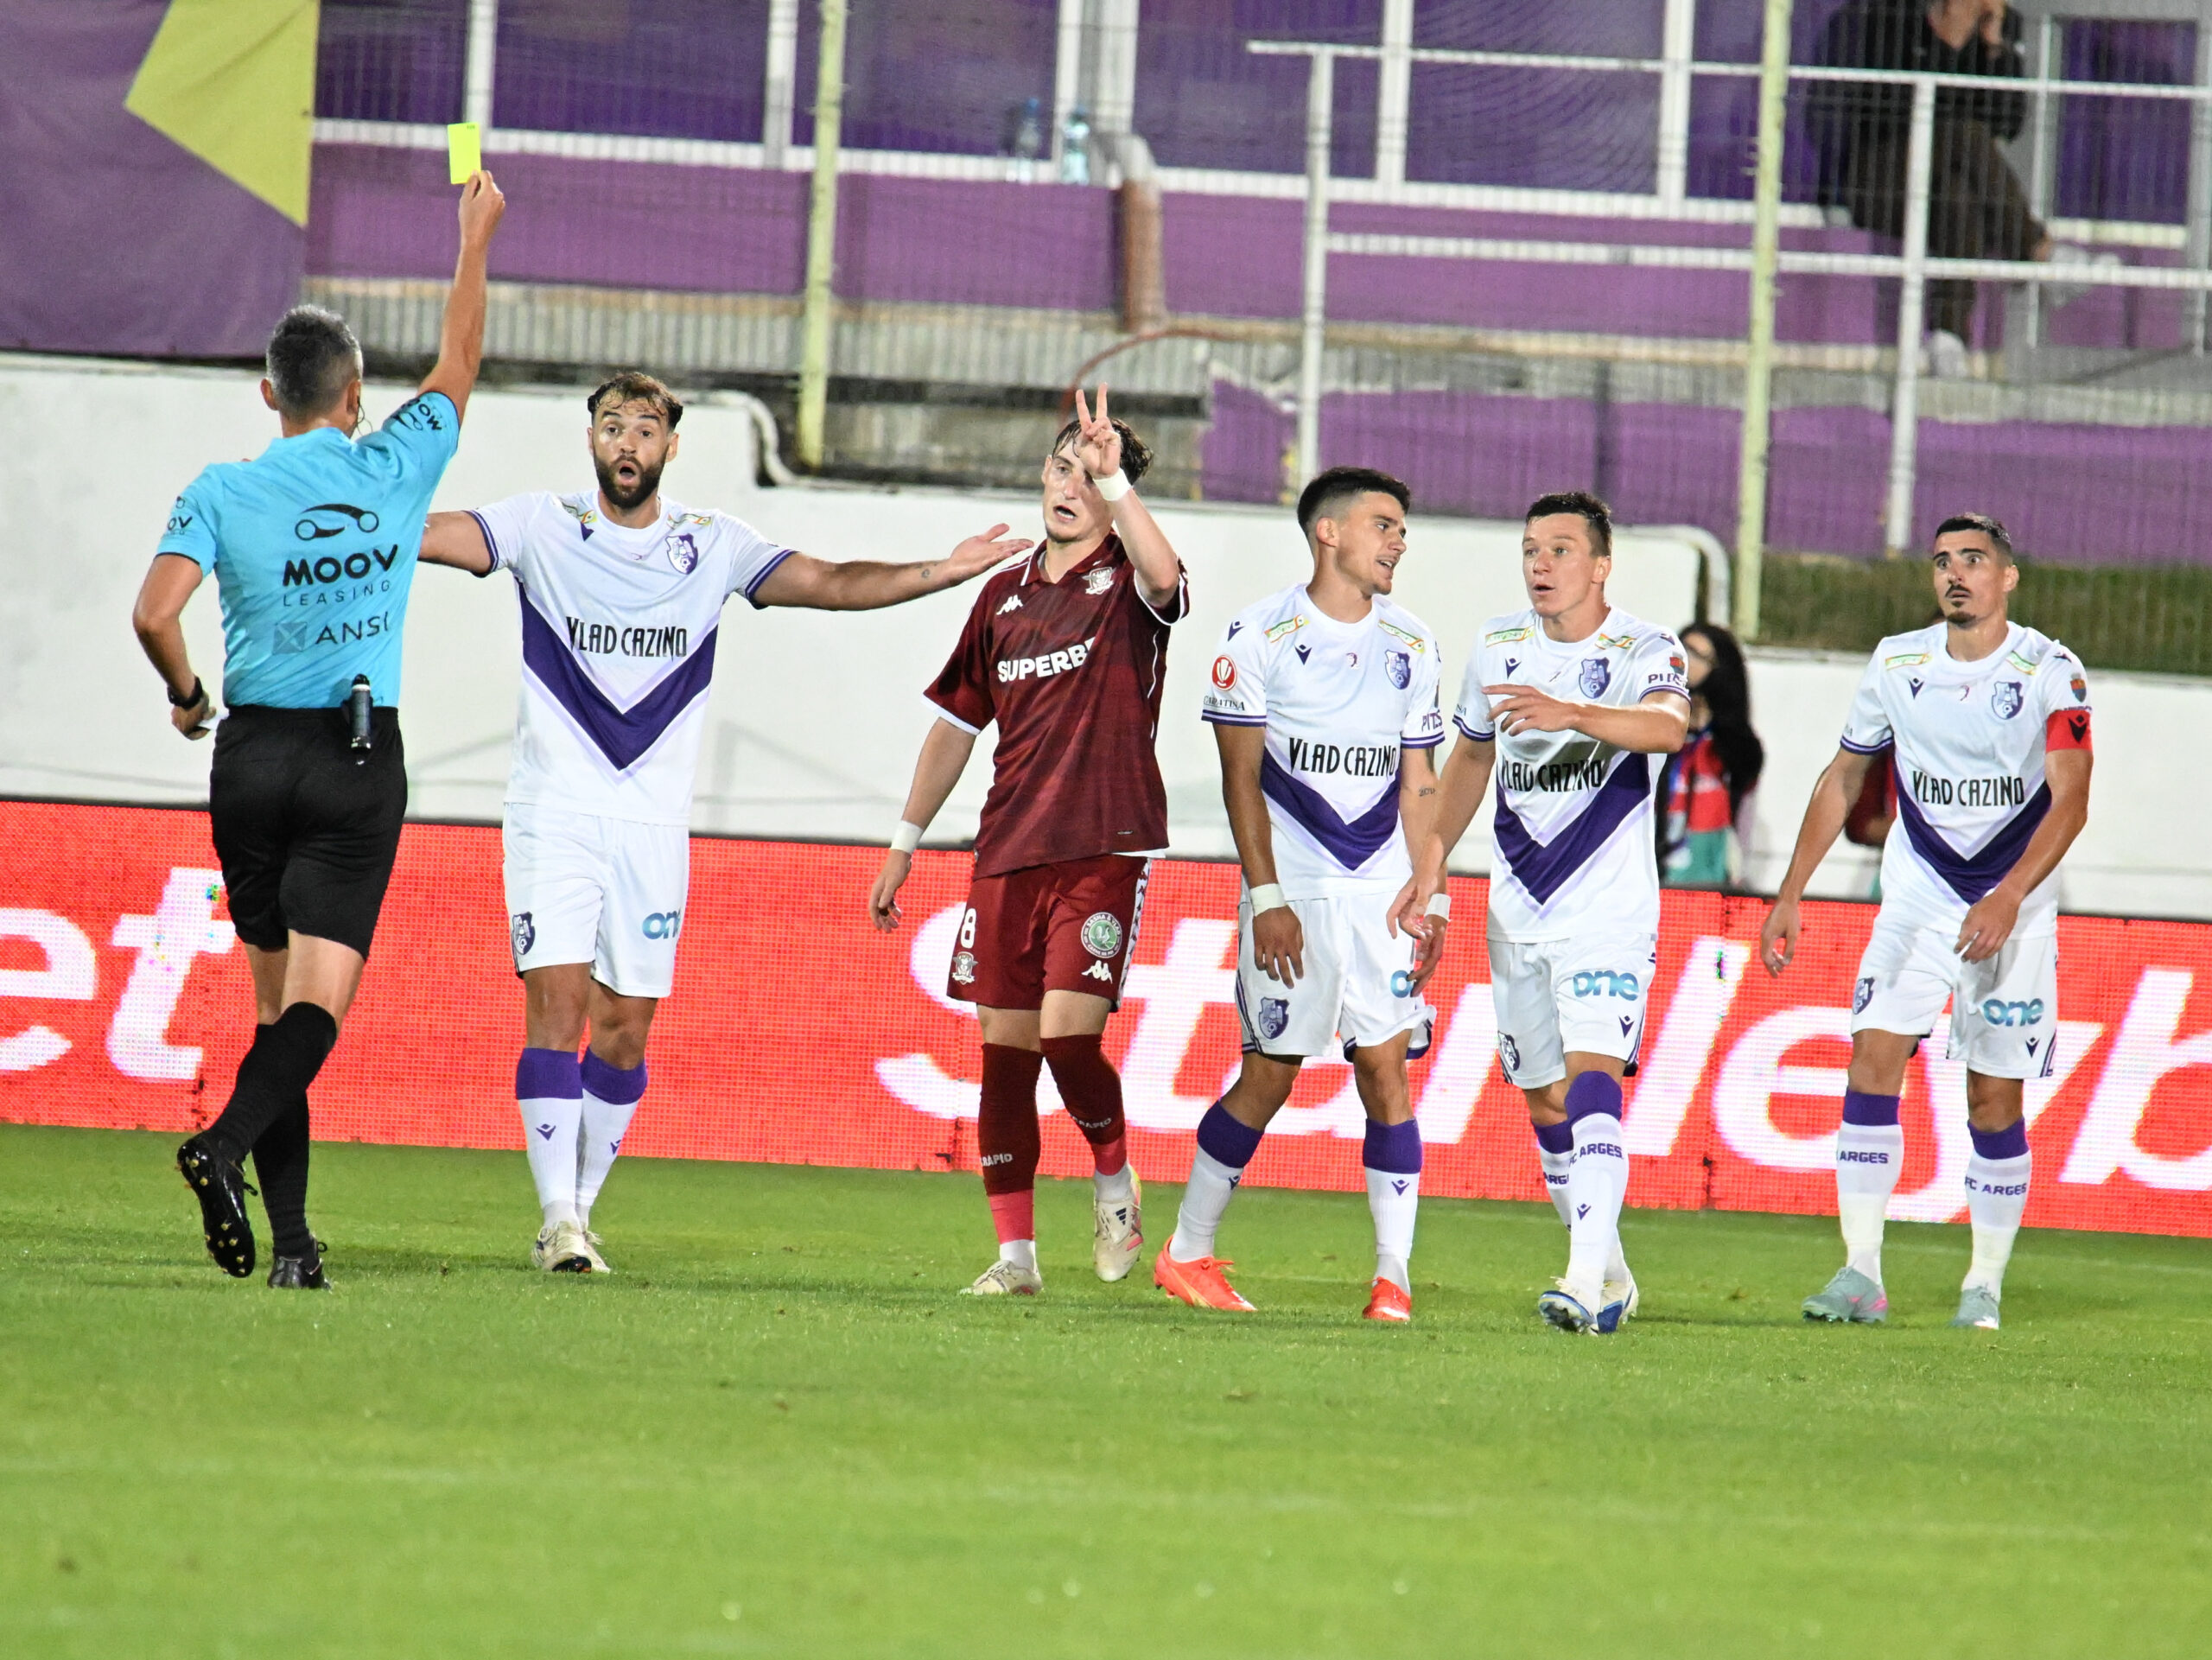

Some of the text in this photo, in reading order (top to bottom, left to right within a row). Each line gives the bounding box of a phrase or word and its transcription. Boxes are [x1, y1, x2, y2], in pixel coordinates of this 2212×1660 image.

[283, 544, 398, 587] MOOV
[283, 580, 391, 607] LEASING
[315, 611, 389, 645] ANSI
[566, 616, 687, 662] VLAD CAZINO
[1289, 737, 1396, 779] VLAD CAZINO
[1913, 771, 2025, 810] VLAD CAZINO
[961, 907, 976, 949] 8
[1573, 970, 1639, 1002] one
[1982, 998, 2044, 1027] one
[1840, 1150, 1889, 1164] ARGES
[1965, 1176, 2027, 1196] FC ARGES
